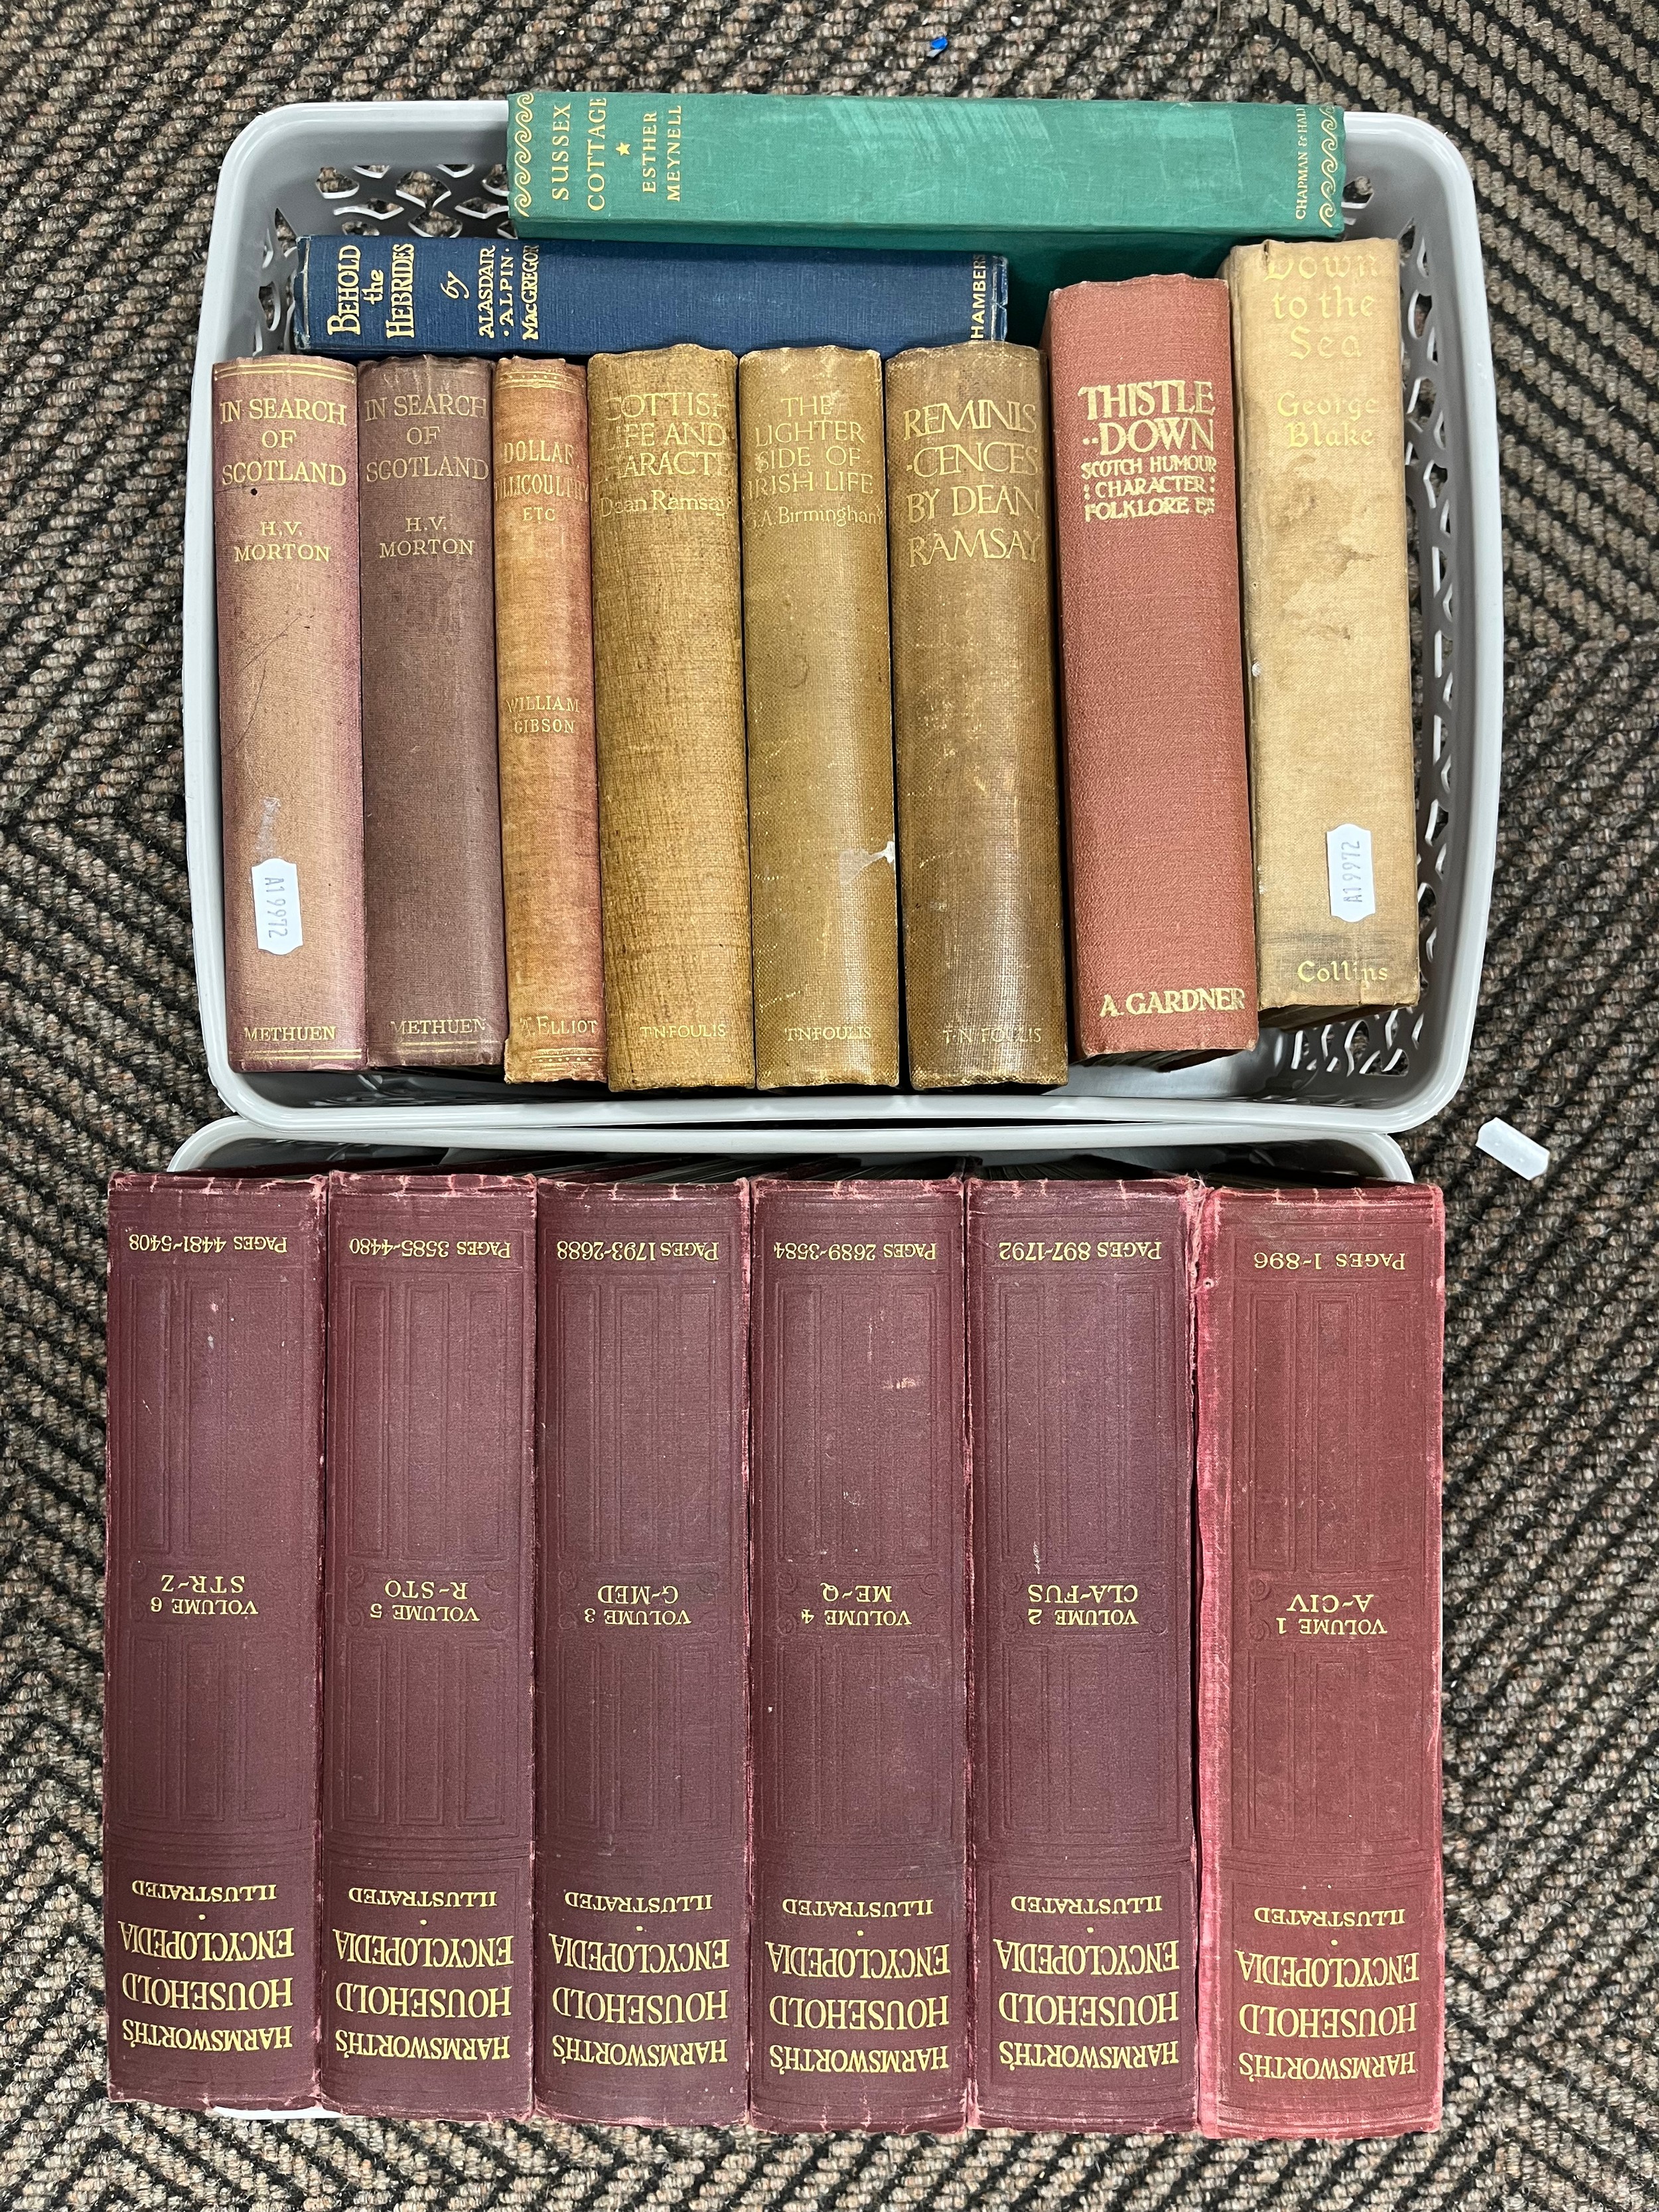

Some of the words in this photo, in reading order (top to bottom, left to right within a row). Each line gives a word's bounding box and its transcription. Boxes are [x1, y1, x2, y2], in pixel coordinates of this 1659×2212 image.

[551, 103, 571, 201] SUSSEX
[642, 111, 657, 192] ESTHER
[1298, 135, 1308, 146] &
[587, 98, 607, 211] COTTAGE
[668, 106, 682, 202] MEYNELL
[1296, 151, 1308, 219] CHAPMAN
[326, 245, 361, 336] BEHOLD
[363, 269, 385, 305] the
[386, 244, 415, 339] HEBRIDES
[441, 271, 470, 299] by
[478, 245, 496, 339] ALASDAIR
[970, 254, 986, 338] HAMBERS
[1271, 292, 1307, 319] to
[1319, 285, 1374, 319] the
[1289, 326, 1361, 360] Sea
[220, 400, 241, 424] IN
[249, 398, 347, 425] SEARCH
[364, 398, 388, 422] IN
[394, 394, 487, 420] SEARCH
[781, 396, 832, 417] THE
[1078, 380, 1216, 421] THISTLE
[1277, 392, 1379, 421] George
[755, 420, 865, 447] LIGHTER
[903, 400, 1037, 441] REMINIS
[261, 429, 297, 449] OF
[406, 426, 441, 445] OF
[664, 422, 727, 447] AND
[1286, 421, 1374, 449] Blake
[366, 456, 490, 482] SCOTLAND
[756, 447, 811, 473] SIDE
[826, 445, 861, 467] OF
[1081, 458, 1142, 479] SCOTCH
[1150, 455, 1216, 473] HUMOUR
[222, 460, 347, 487] SCOTLAND
[748, 471, 814, 500] IRISH
[826, 471, 873, 494] LIFE
[601, 498, 648, 517] Dean
[906, 488, 940, 523] BY
[951, 484, 1040, 518] DEAN
[1084, 496, 1189, 522] FOLKLORE
[234, 544, 330, 563] MORTON
[380, 539, 475, 559] MORTON
[908, 528, 1041, 567] RAMSAY
[506, 696, 579, 713] WILLIAM
[514, 718, 575, 734] GIBSON
[1297, 960, 1388, 983] Collins
[1100, 995, 1124, 1017] A.
[1125, 988, 1245, 1015] GARDNER
[244, 1026, 336, 1041] METHUEN
[390, 1018, 486, 1035] METHUEN
[129, 1234, 226, 1254] 4481-5408
[234, 1236, 288, 1253] PAGES
[349, 1238, 449, 1257] 3585-4480
[457, 1242, 512, 1258] PAGES
[557, 1241, 655, 1260] 1793-2688
[662, 1242, 719, 1260] PAGES
[774, 1242, 875, 1260] 2689-3584
[883, 1243, 936, 1260] PAGES
[999, 1242, 1090, 1261] 897-1792
[1098, 1242, 1162, 1260] PAGES
[1254, 1252, 1322, 1270] 1-896
[1336, 1252, 1406, 1270] PAGES
[151, 1597, 162, 1612] 6
[172, 1598, 258, 1615] VOLUME
[370, 1604, 382, 1618] 5
[392, 1605, 480, 1622] VOLUME
[584, 1608, 595, 1623] 3
[604, 1609, 692, 1625] VOLUME
[802, 1609, 814, 1624] 4
[1028, 1609, 1041, 1625] 2
[1054, 1609, 1139, 1626] VOLUME
[825, 1610, 912, 1627] VOLUME
[1276, 1617, 1286, 1634] 1
[1299, 1618, 1388, 1635] VOLUME
[133, 1880, 277, 1903] ILLUSTRATED
[348, 1887, 497, 1907] ILLUSTRATED
[564, 1891, 713, 1914] ILLUSTRATED
[782, 1898, 934, 1917] ILLUSTRATED
[1011, 1895, 1162, 1915] ILLUSTRATED
[1254, 1907, 1406, 1927] ILLUSTRATED
[118, 1921, 294, 1962] ENCYCLOPEDIA
[332, 1929, 514, 1969] ENCYCLOPEDIA
[548, 1933, 730, 1973] ENCYCLOPEDIA
[765, 1941, 950, 1979] ENCYCLOPEDIA
[993, 1939, 1180, 1975] ENCYCLOPEDIA
[1234, 1950, 1420, 1987] ENCYCLOPEDIA
[122, 1973, 293, 2011] HOUSEHOLD
[335, 1982, 512, 2018] HOUSEHOLD
[552, 1988, 728, 2025] HOUSEHOLD
[769, 1995, 949, 2031] HOUSEHOLD
[999, 1991, 1179, 2026] HOUSEHOLD
[1240, 2002, 1417, 2038] HOUSEHOLD
[122, 2019, 293, 2052] HARMSWORTH'S
[334, 2030, 510, 2061] HARMSWORTH'S
[551, 2035, 727, 2067] HARMSWORTH'S
[769, 2044, 949, 2075] HARMSWORTH'S
[999, 2039, 1179, 2071] HARMSWORTH'S
[1239, 2051, 1415, 2083] HARMSWORTH'S
